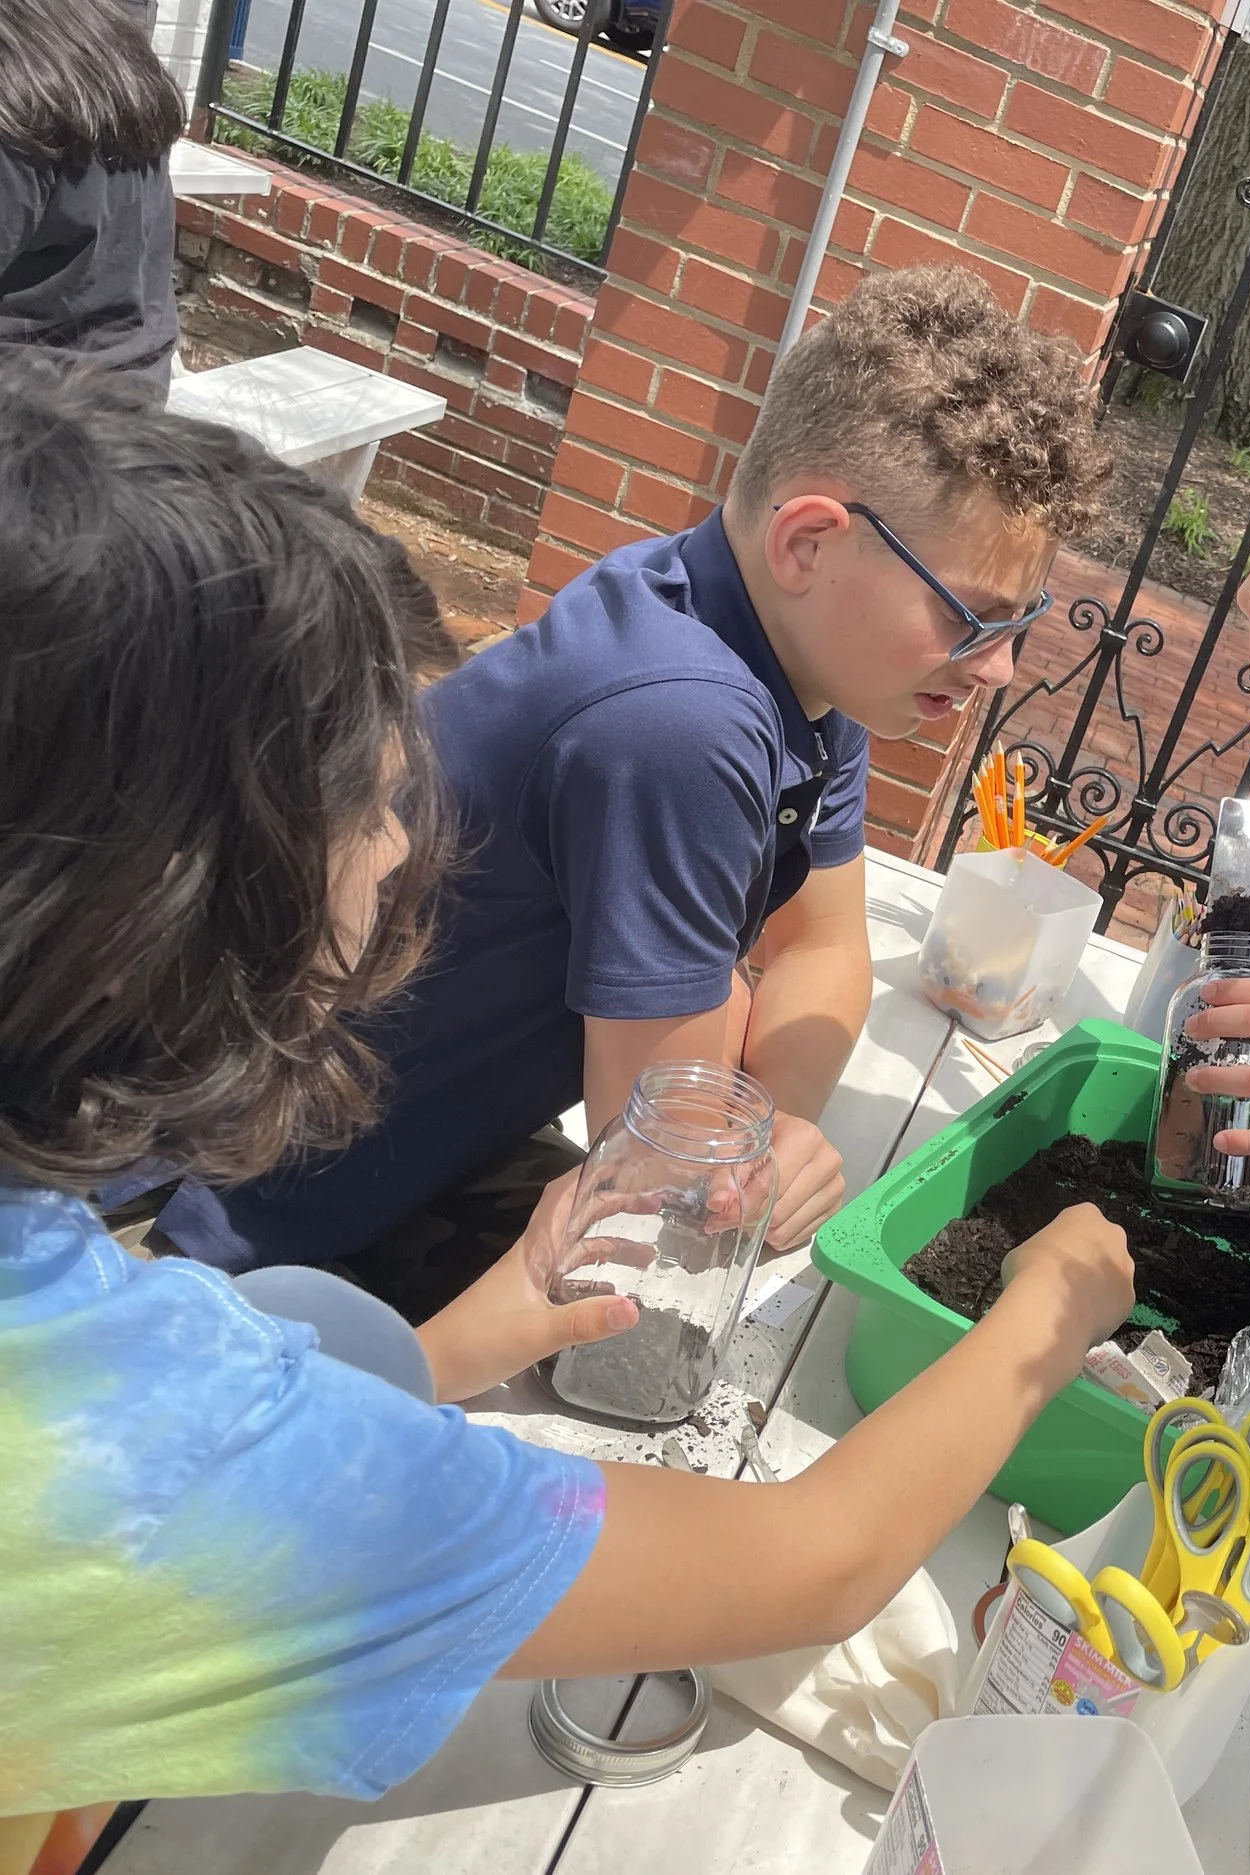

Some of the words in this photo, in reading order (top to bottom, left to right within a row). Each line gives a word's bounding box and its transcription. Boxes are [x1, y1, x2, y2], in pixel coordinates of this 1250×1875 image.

[1016, 1597, 1044, 1630] Calories
[1052, 1629, 1066, 1647] 90
[1075, 1636, 1105, 1665] SKIM
